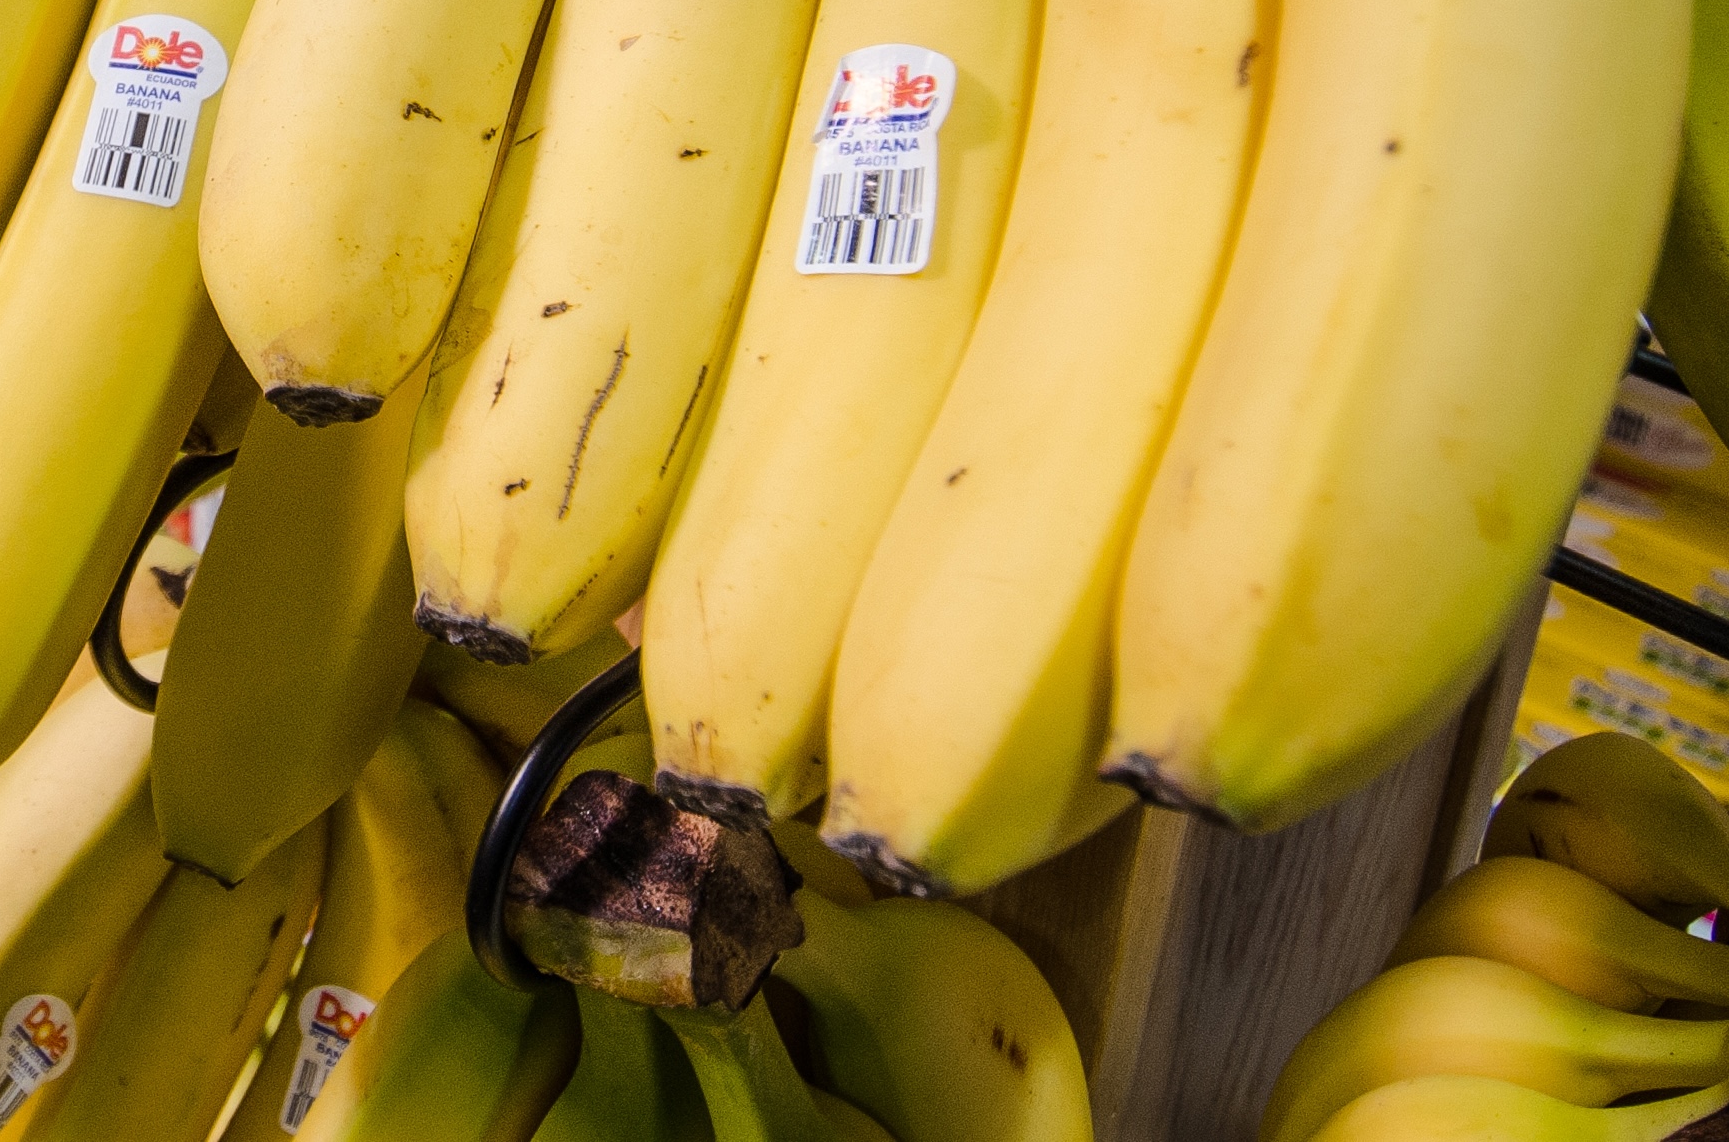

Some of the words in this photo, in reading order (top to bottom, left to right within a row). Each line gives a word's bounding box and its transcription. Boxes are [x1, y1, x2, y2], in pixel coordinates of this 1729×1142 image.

[111, 25, 204, 70] Dole
[115, 83, 182, 103] BANANA
[146, 74, 198, 89] ECUADOR
[833, 64, 939, 114] le
[126, 97, 163, 111] #4011
[22, 999, 69, 1062] Dole
[315, 990, 367, 1039] Dol
[7, 1045, 41, 1081] BANANA
